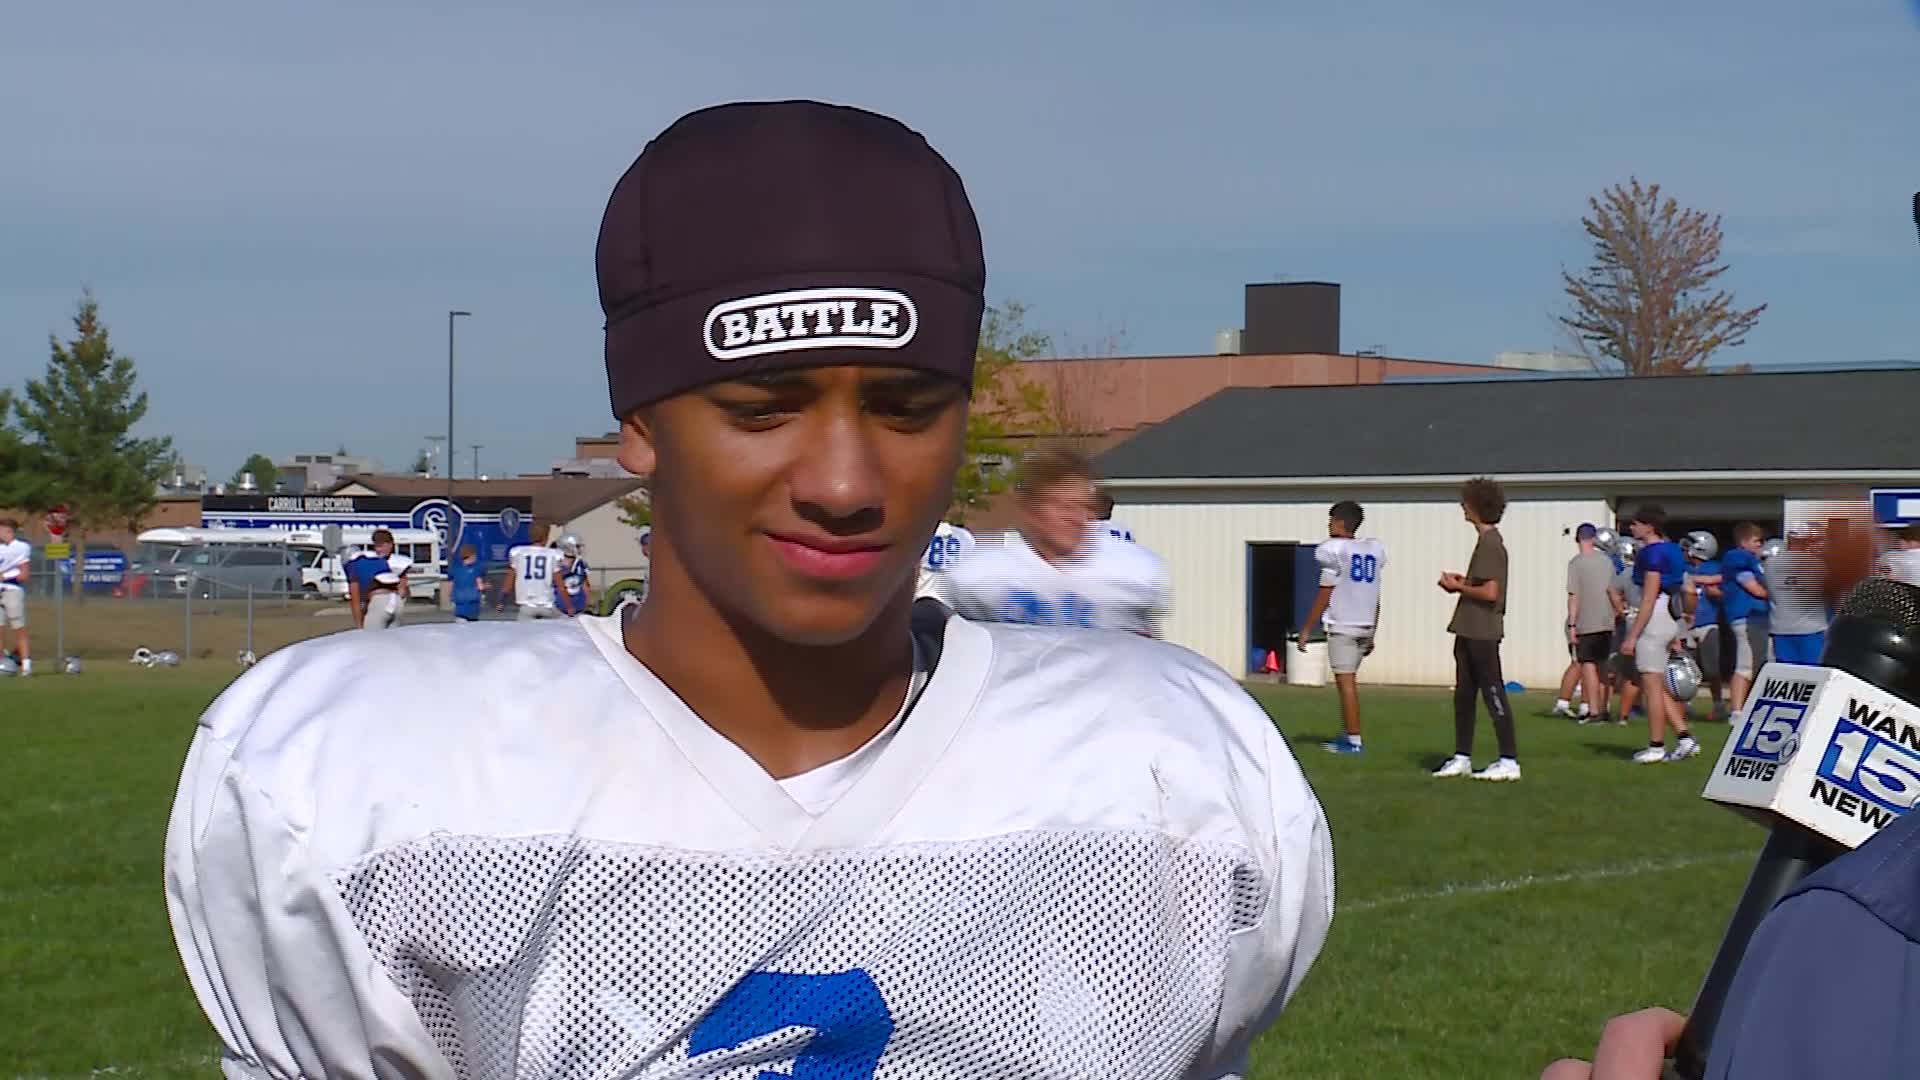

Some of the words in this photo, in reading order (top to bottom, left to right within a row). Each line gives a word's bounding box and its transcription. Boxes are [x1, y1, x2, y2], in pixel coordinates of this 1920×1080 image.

[720, 302, 900, 346] BATTLE
[268, 497, 303, 512] CARROLL
[304, 497, 323, 512] HIGH
[324, 497, 354, 512] SCHOOL
[928, 535, 961, 567] 89
[524, 555, 546, 580] 19
[1351, 553, 1376, 583] 80
[1763, 679, 1816, 702] WANE
[1743, 704, 1804, 754] 15
[1724, 756, 1778, 782] NEWS
[1831, 731, 1920, 808] 15
[1809, 778, 1892, 830] NEW
